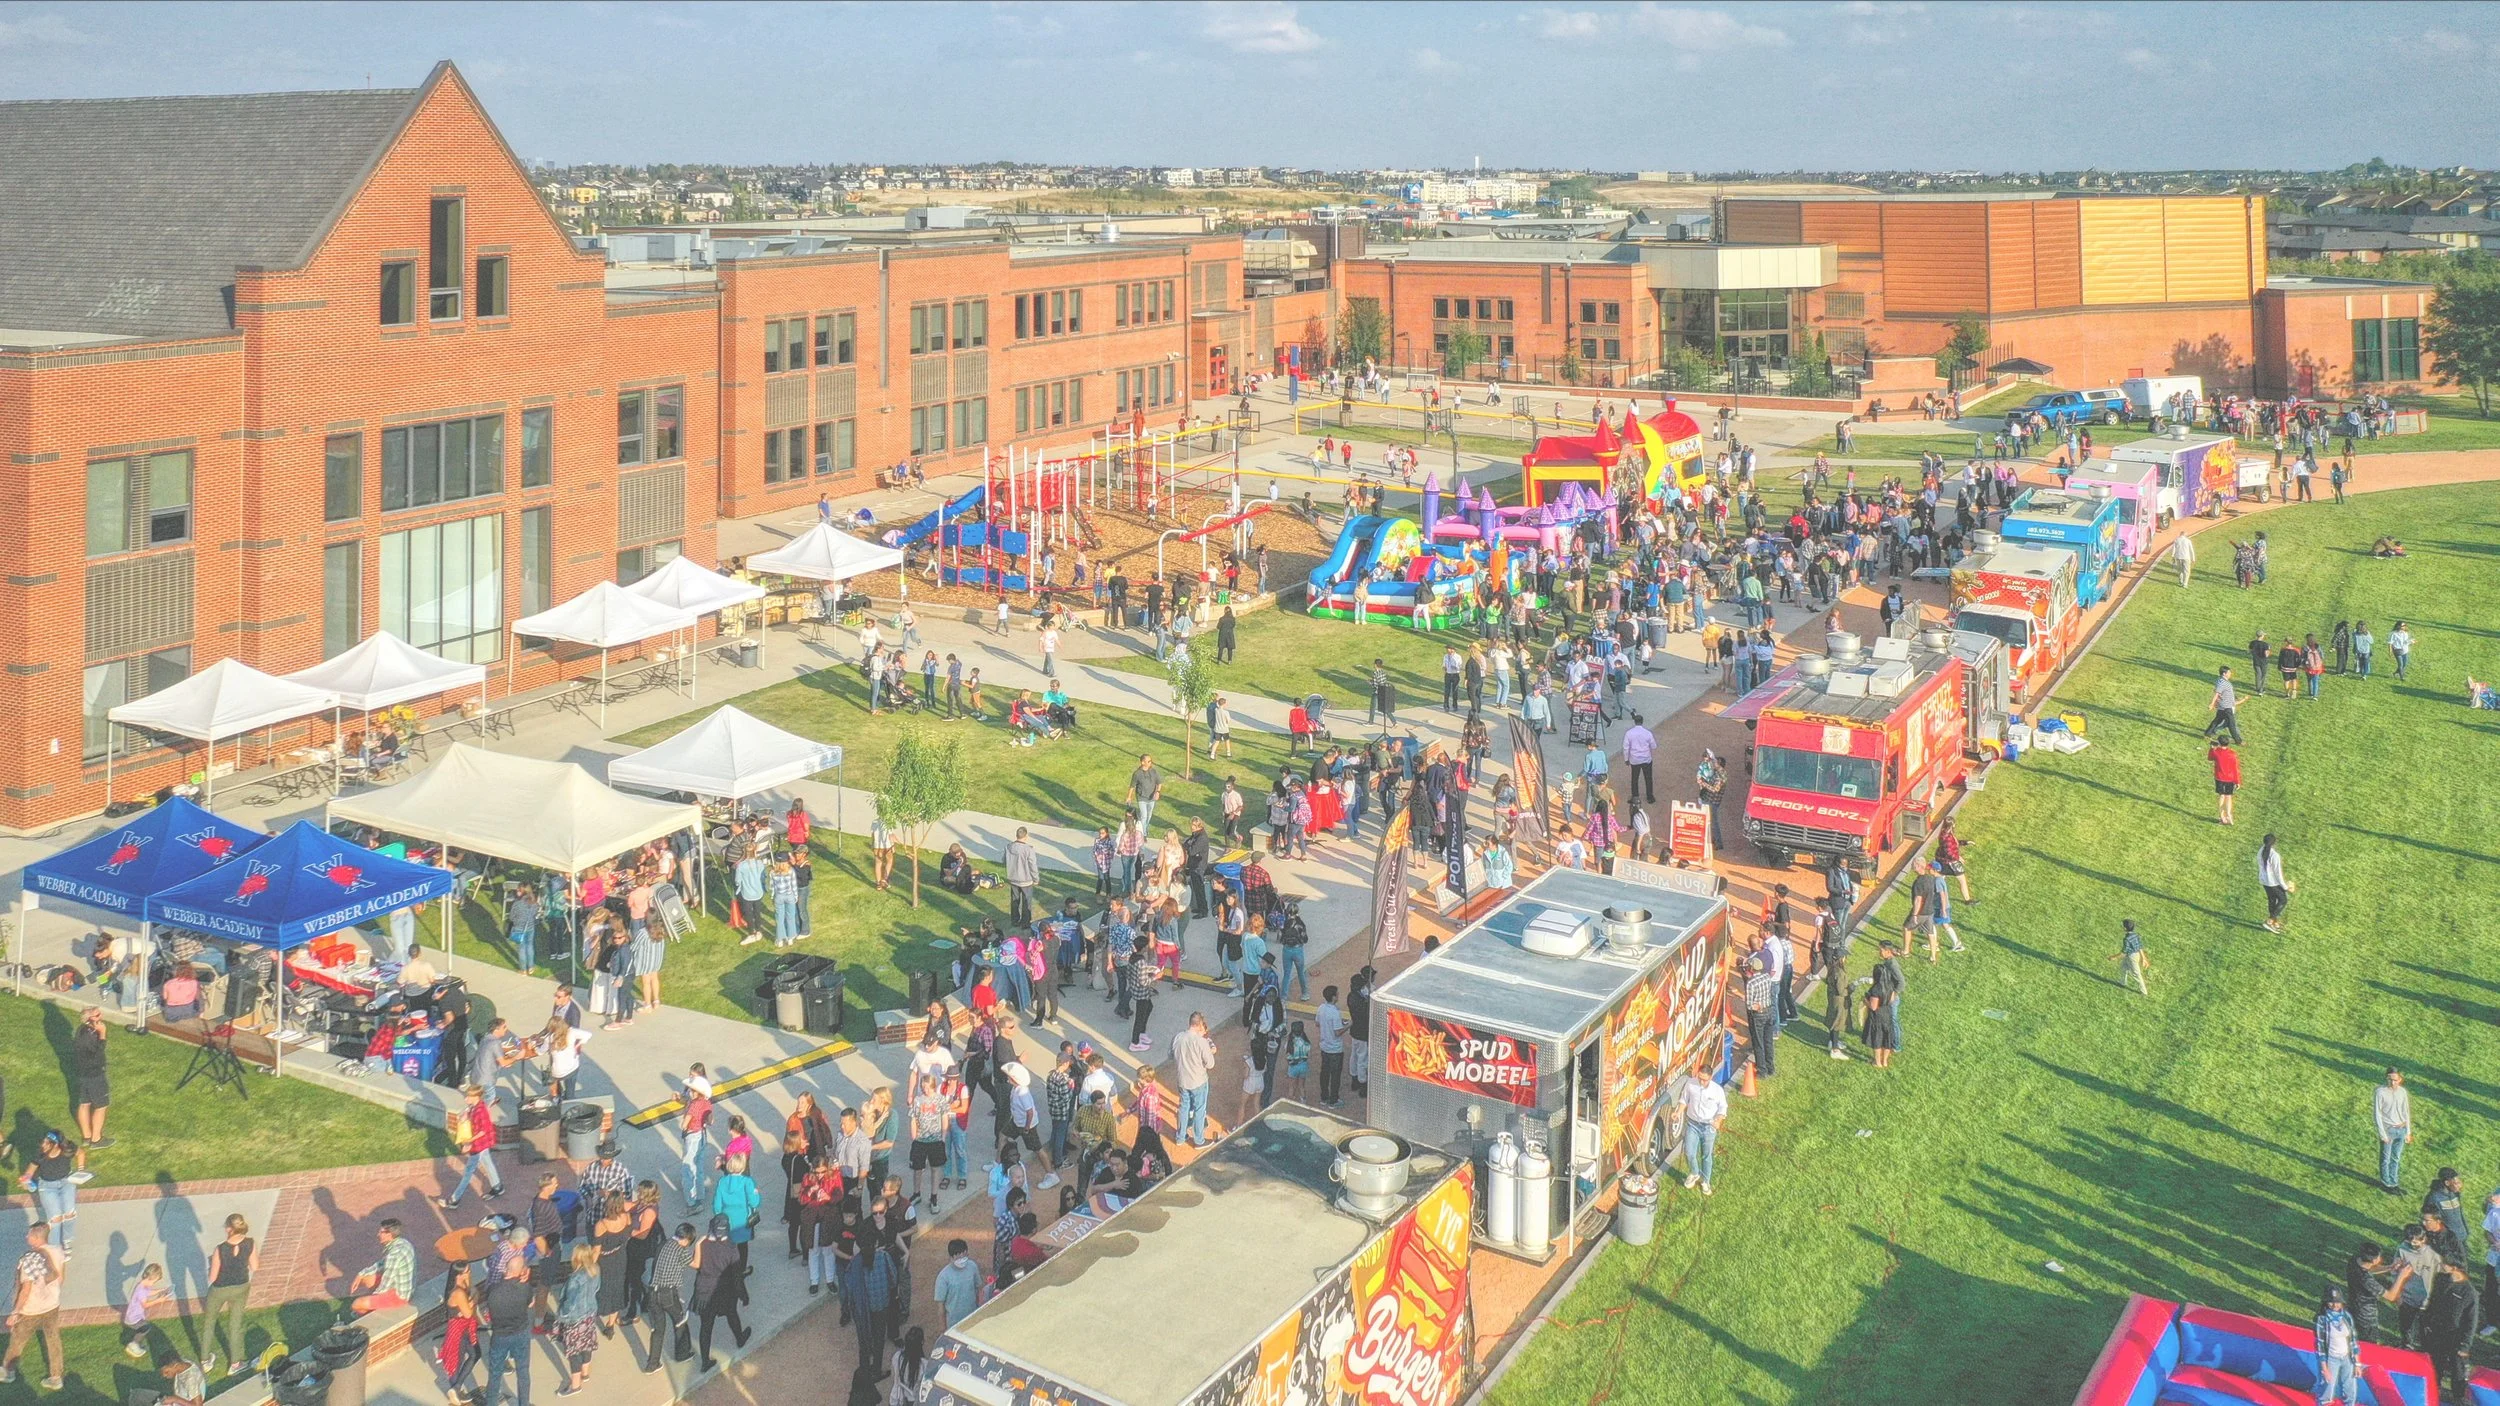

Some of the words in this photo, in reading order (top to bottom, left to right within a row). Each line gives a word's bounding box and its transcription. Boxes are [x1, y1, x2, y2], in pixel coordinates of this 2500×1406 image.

[1817, 804, 1859, 820] BOYZ
[38, 875, 77, 897] WEBBER
[78, 884, 129, 909] ACADEMY
[303, 904, 363, 934] WEBBER
[365, 881, 432, 915] ACADEMY
[1385, 893, 1398, 916] Cut
[162, 905, 208, 928] WEBBER
[208, 916, 263, 940] ACADEMY
[1384, 919, 1397, 952] Fresh
[1669, 936, 1706, 1020] SPUD
[1658, 958, 1717, 1081] MOBEEL
[1459, 1039, 1512, 1061] SPUD
[1637, 1026, 1655, 1051] FRIES
[1445, 1061, 1531, 1086] MOBEEL
[1433, 1200, 1463, 1254] YYC
